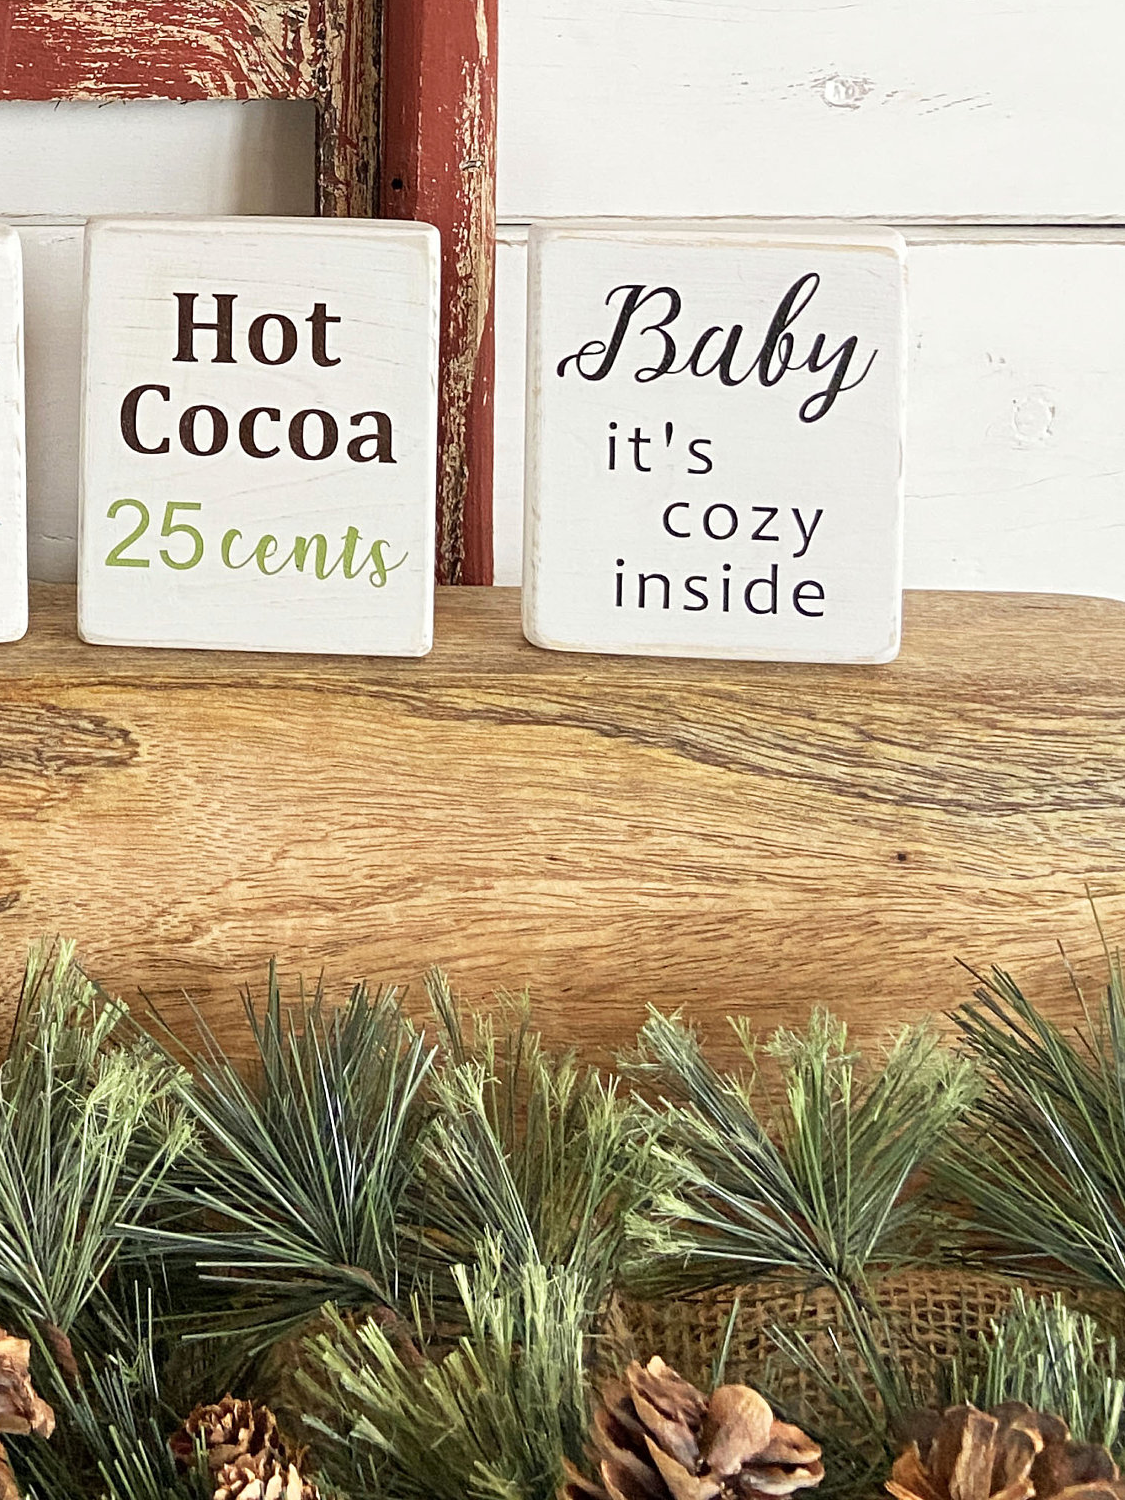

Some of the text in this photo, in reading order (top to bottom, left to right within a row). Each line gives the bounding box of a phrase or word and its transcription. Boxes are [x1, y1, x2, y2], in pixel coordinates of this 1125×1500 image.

[171, 291, 342, 368] Hot
[556, 272, 878, 423] Baby
[118, 384, 397, 465] Cocoa
[606, 421, 714, 476] it's
[104, 498, 408, 588] 25 cents
[662, 502, 824, 558] cozy
[615, 559, 826, 618] inside
